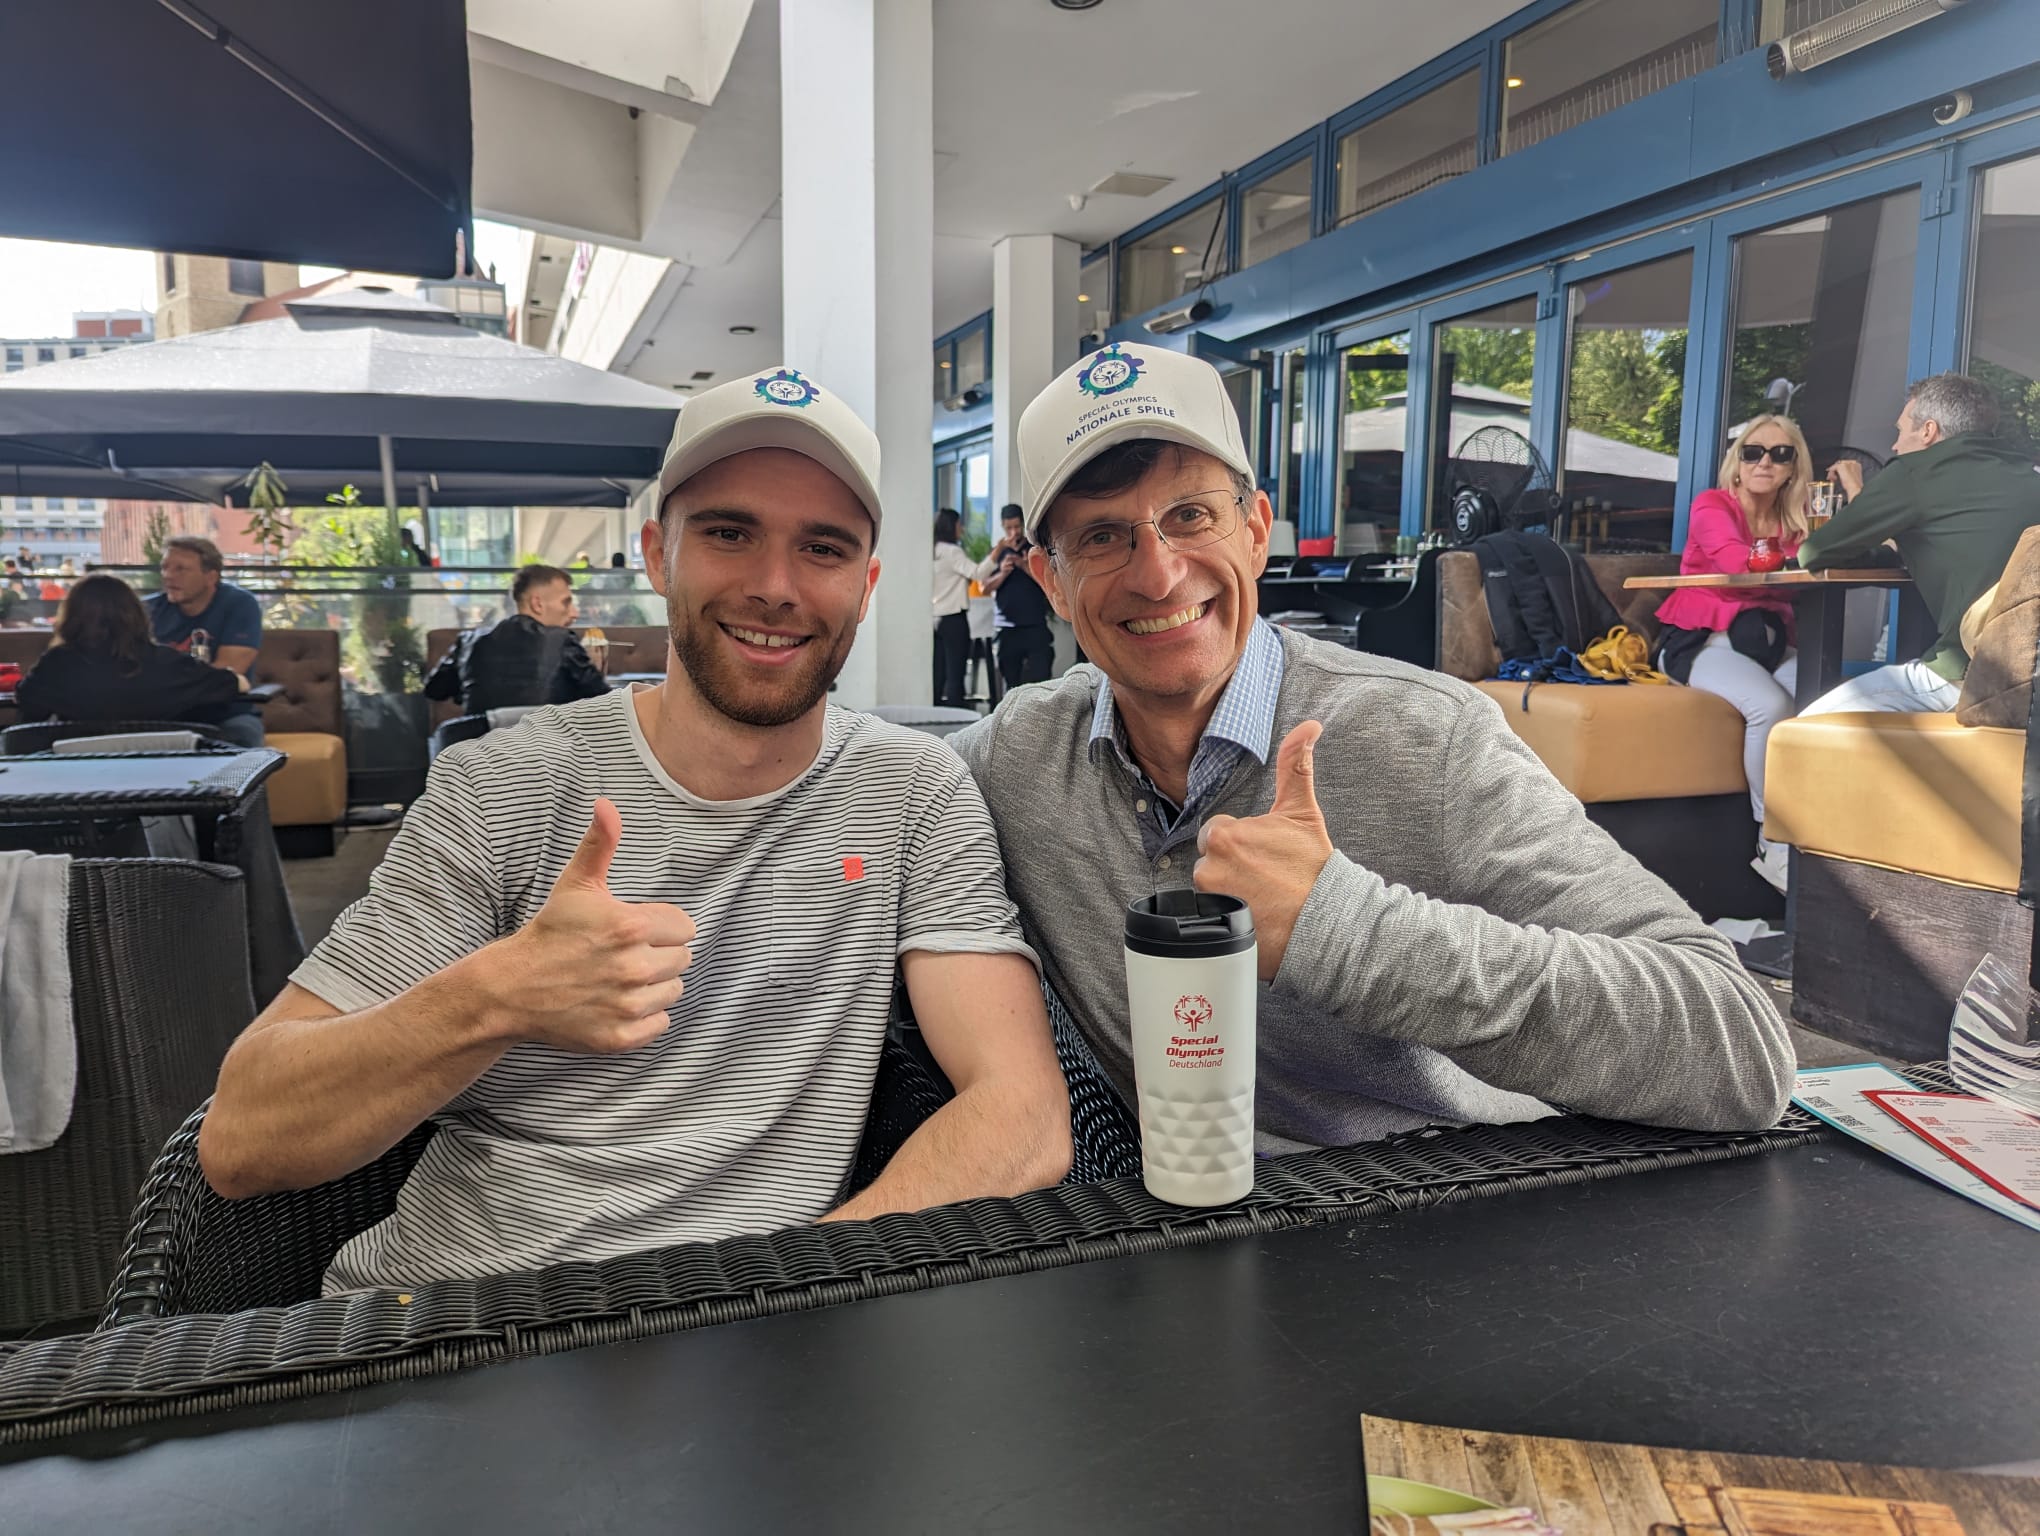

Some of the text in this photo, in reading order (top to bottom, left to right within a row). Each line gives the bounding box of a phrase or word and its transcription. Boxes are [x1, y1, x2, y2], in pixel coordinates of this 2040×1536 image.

[1078, 396, 1157, 423] SPECIAL OLYMPICS
[1066, 405, 1175, 445] NATIONALE SPIELE
[1171, 1035, 1218, 1047] Special
[1166, 1047, 1224, 1058] Olympics
[1169, 1058, 1222, 1069] Deutschland
